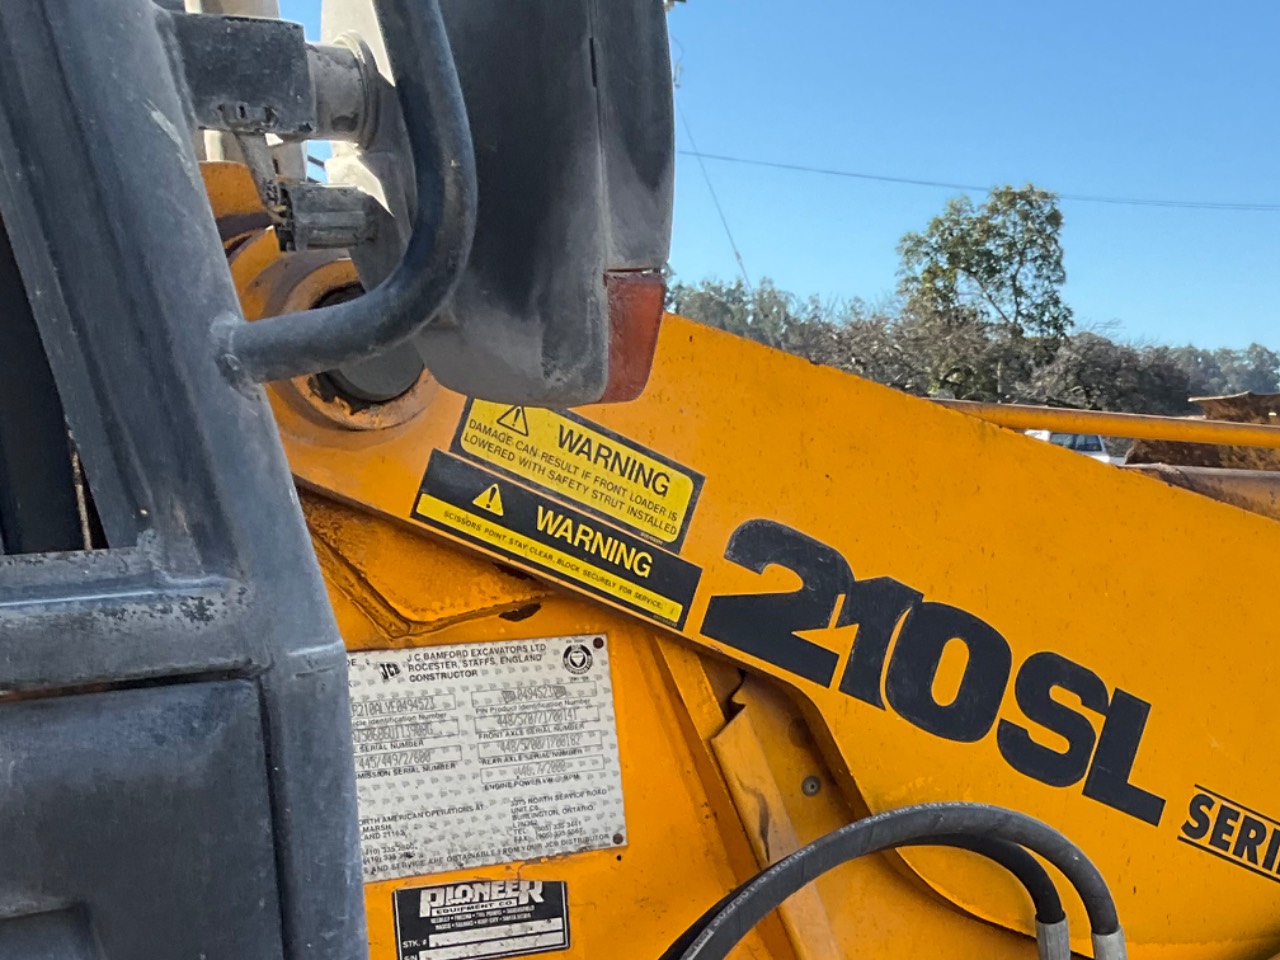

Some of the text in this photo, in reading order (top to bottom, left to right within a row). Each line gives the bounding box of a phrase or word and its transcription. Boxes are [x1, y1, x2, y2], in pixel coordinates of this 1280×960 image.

[558, 424, 670, 497] WARNING
[469, 419, 678, 522] DAMAGE CAN RESULT IF FRONT LOADER IS
[464, 432, 678, 536] LOWERED WITH SAFETY STRUT INSTALLED
[536, 505, 653, 578] WARNING
[444, 510, 482, 531] SCISSORS
[508, 538, 528, 550] STAY
[556, 558, 580, 572] BLOCK
[582, 570, 616, 588] SECURELY
[619, 583, 632, 596] FOR
[423, 650, 468, 660] BAMFORD
[470, 645, 528, 657] EXCAVATORS
[530, 644, 546, 652] LTD
[500, 654, 542, 664] ENGLAND
[380, 662, 400, 680] JCB
[410, 670, 478, 682] CONSTRUCTOR
[700, 518, 1167, 827] 210SL
[479, 732, 503, 740] FRONT
[554, 723, 584, 732] NUMBER
[360, 740, 424, 752] SERIAL NUMBER
[394, 768, 420, 776] SERIAL
[422, 763, 456, 772] NUMBER
[528, 795, 552, 804] NORTH
[554, 791, 584, 801] SERVICE
[586, 789, 608, 797] ROAD
[382, 812, 424, 824] AMERICAN
[424, 806, 474, 818] OPERATIONS
[511, 807, 527, 815] UNIT
[562, 804, 594, 815] ONTARIO
[362, 824, 392, 833] MARSH
[392, 860, 424, 870] SERVICE
[560, 834, 609, 846] DISTRIBUTOR
[419, 881, 544, 917] PIONEER
[436, 903, 494, 914] EQUIPMENT
